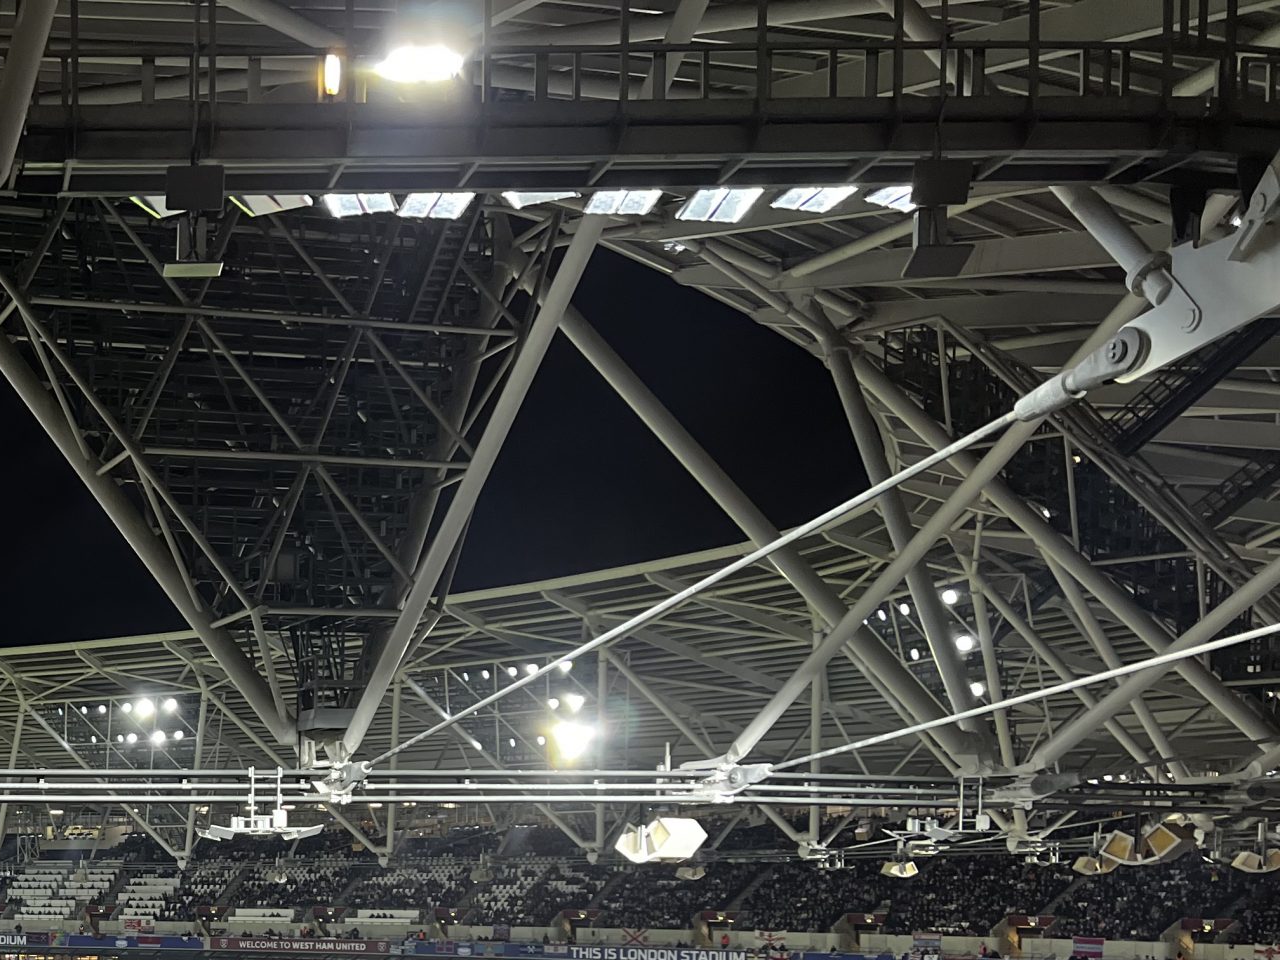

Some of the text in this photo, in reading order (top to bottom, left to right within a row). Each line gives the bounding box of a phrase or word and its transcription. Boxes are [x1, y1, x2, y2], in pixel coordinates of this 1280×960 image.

[239, 940, 366, 951] WELCOME TO WEST HAM UNITED
[570, 946, 602, 959] THIS
[604, 947, 617, 960] IS
